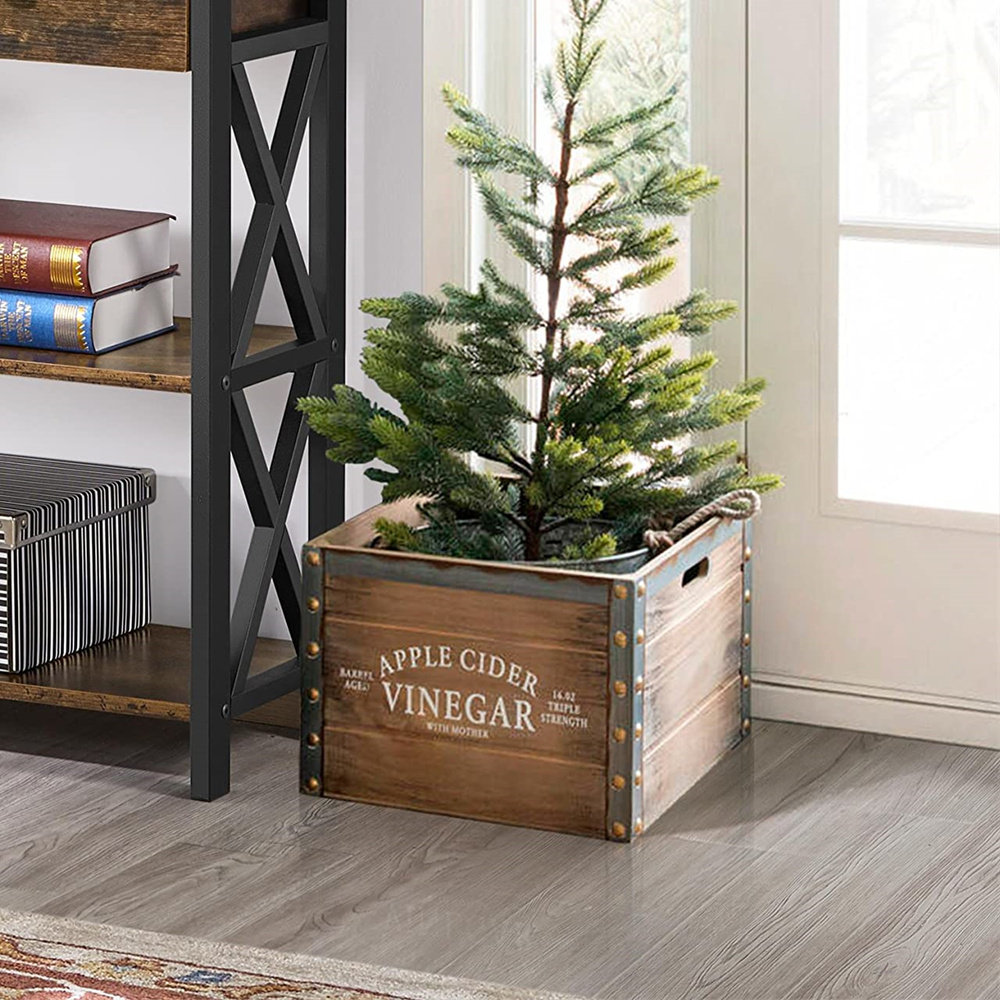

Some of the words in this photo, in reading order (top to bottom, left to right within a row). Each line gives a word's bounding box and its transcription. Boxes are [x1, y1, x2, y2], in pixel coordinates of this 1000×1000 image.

[339, 667, 374, 681] BARREL
[379, 645, 453, 679] APPLE
[459, 648, 539, 698] CIDER
[381, 681, 536, 733] VINEGAR
[547, 700, 581, 715] TRIPLE
[540, 713, 589, 729] STRENGTH
[426, 721, 450, 735] WITH
[451, 724, 490, 739] MOTHER
